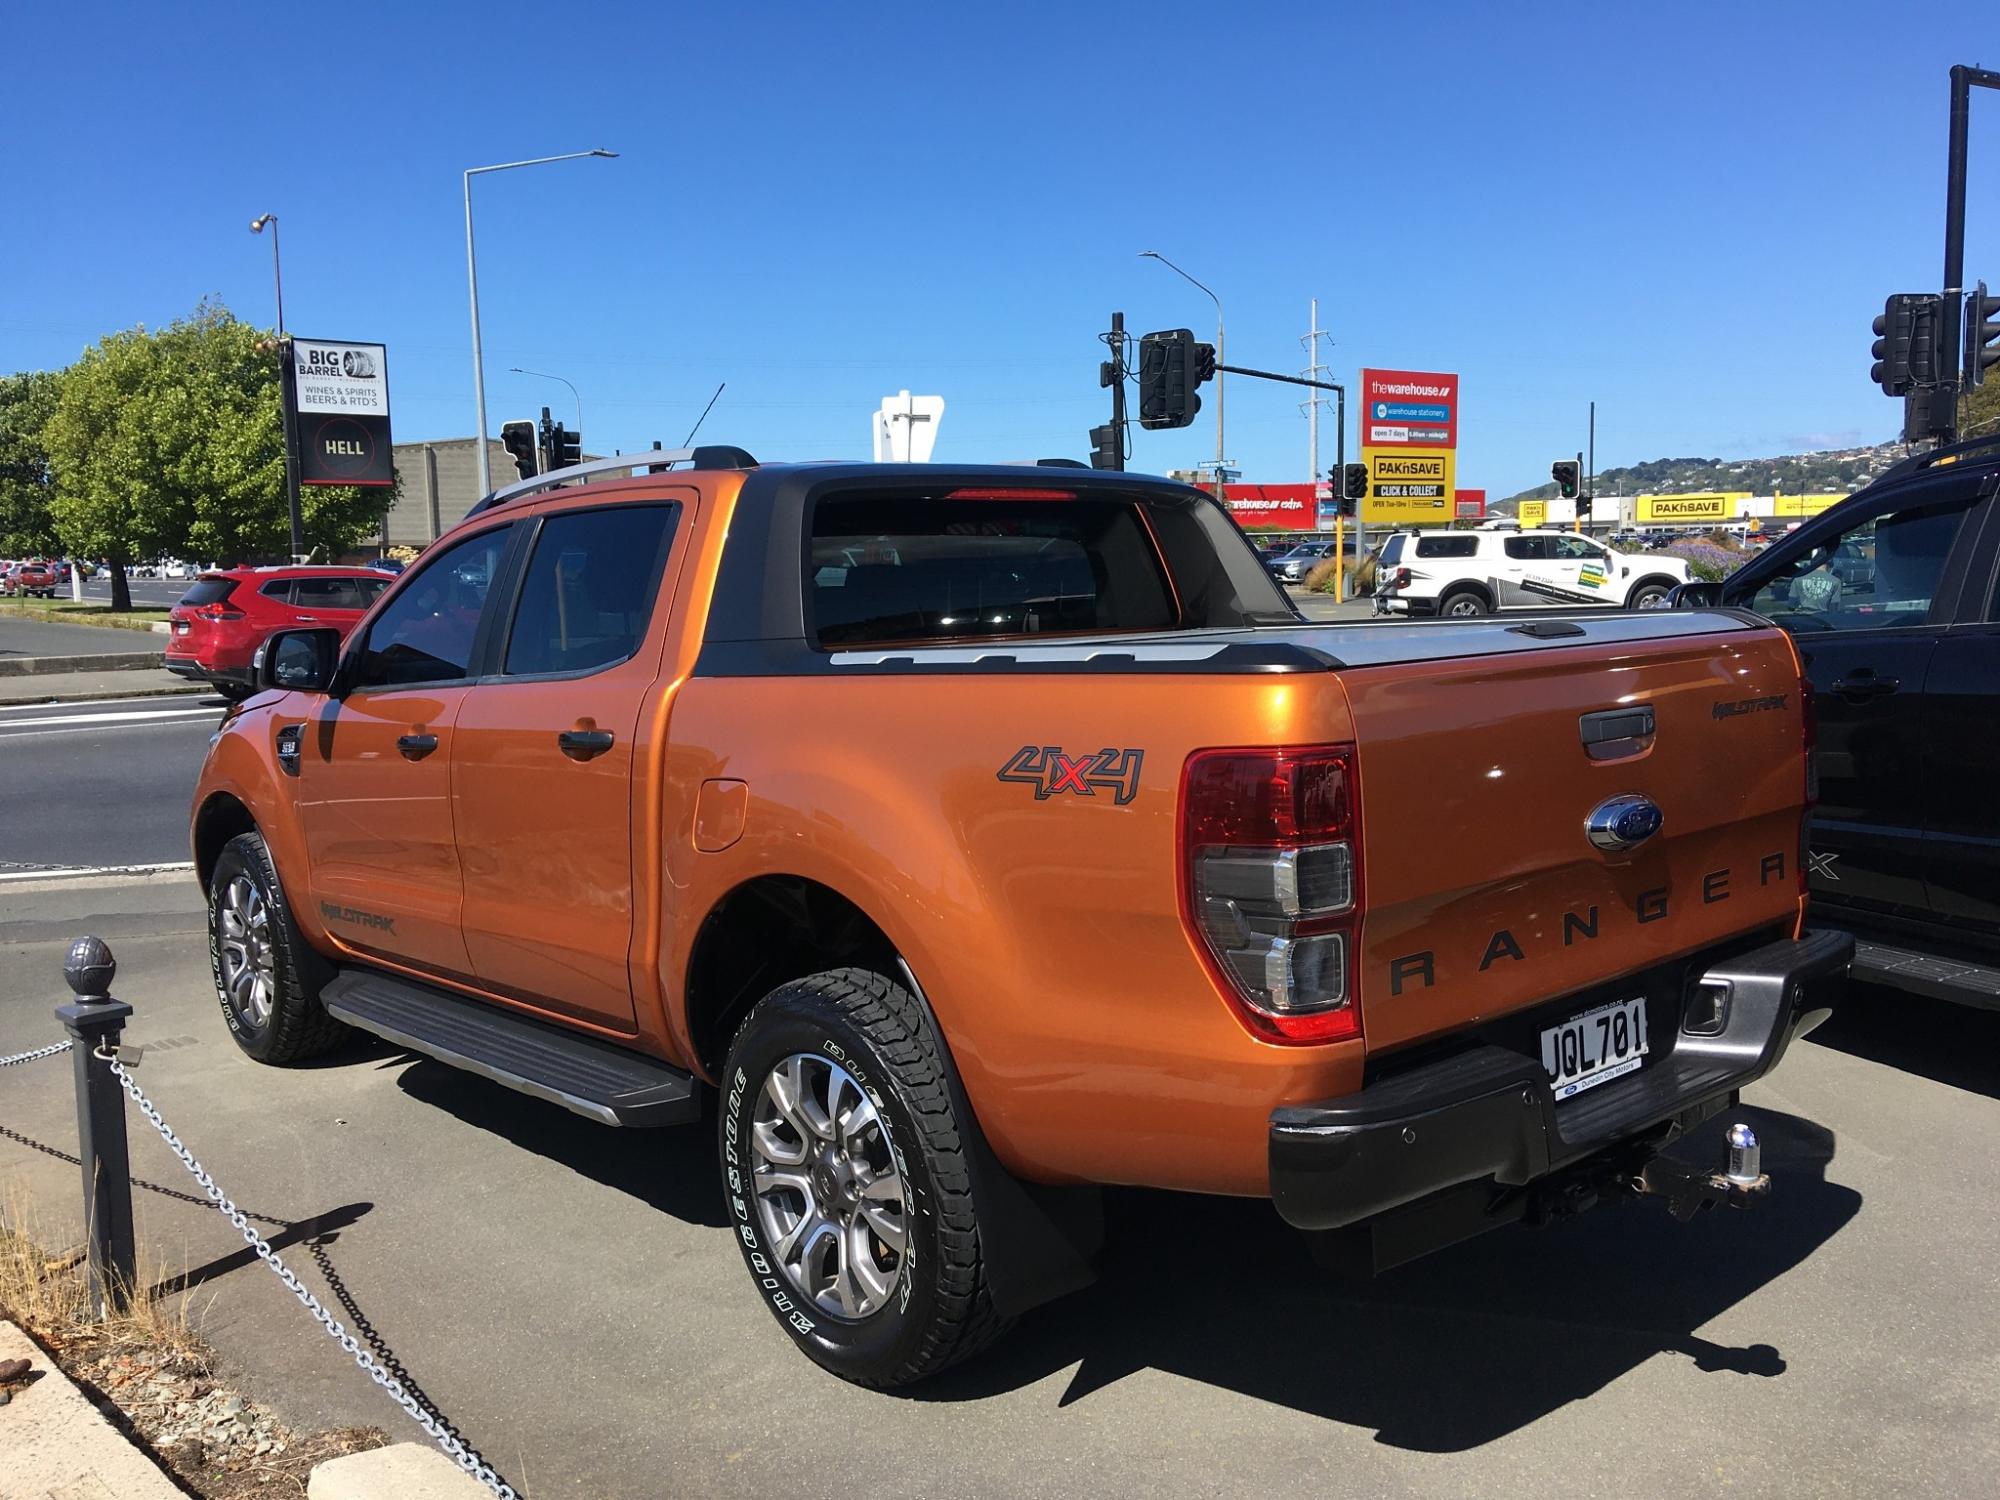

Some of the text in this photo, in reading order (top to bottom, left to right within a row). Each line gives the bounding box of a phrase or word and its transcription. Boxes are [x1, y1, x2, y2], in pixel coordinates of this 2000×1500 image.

[310, 350, 339, 366] BIG
[299, 364, 343, 377] BARREL
[304, 385, 377, 397] WINES & SPIRITS
[305, 395, 378, 407] BEERS & RTD'S
[1387, 407, 1445, 419] warehouse stationery
[1375, 430, 1388, 438] open
[1393, 430, 1406, 438] days
[325, 440, 364, 455] HELL
[1381, 485, 1438, 497] CLICK & COLLECT
[1390, 852, 1785, 996] RANGER
[1548, 1004, 1642, 1084] JQL701
[1581, 1062, 1634, 1088] Dunedin City Motors
[726, 1066, 816, 1336] BRIDGESTONE
